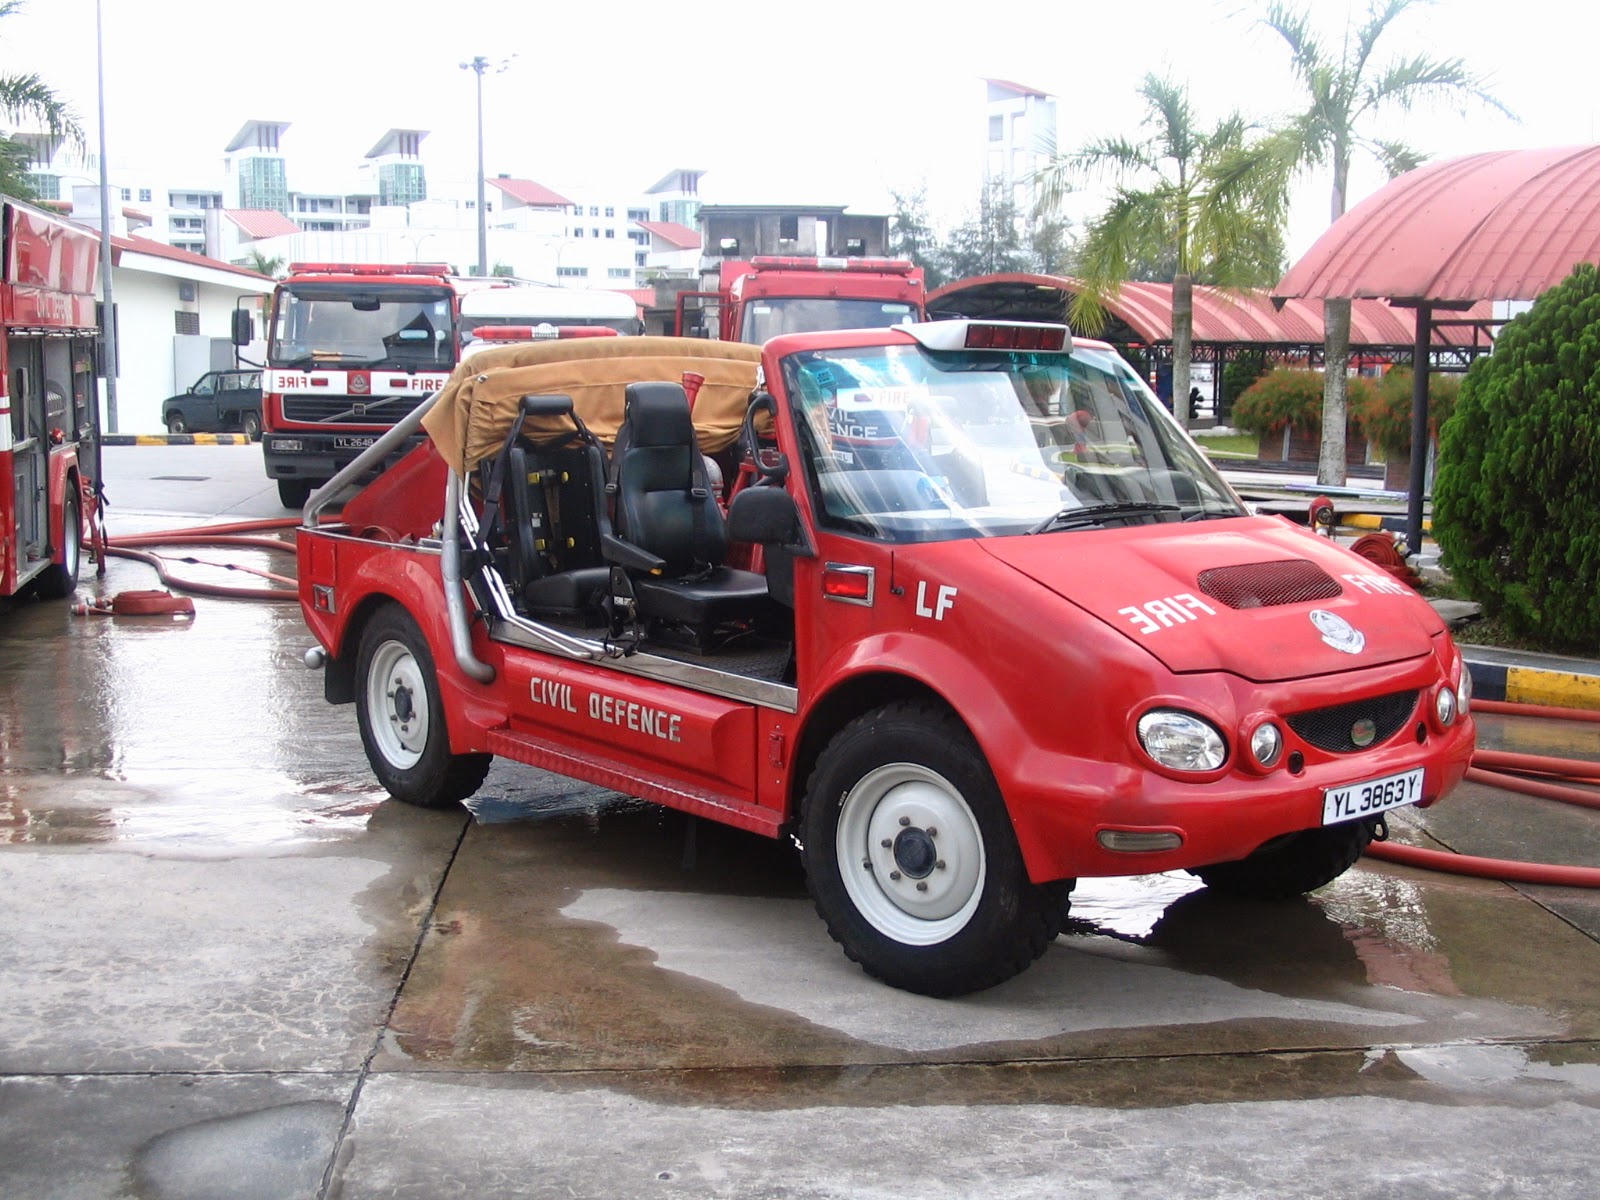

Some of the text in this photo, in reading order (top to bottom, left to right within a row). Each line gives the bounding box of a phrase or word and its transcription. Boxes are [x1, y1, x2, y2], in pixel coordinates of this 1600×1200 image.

[411, 378, 443, 391] FIRE
[826, 407, 856, 423] VIL
[828, 422, 879, 440] ENCE
[916, 580, 958, 621] LF
[530, 677, 682, 743] CIVIL DEFENCE
